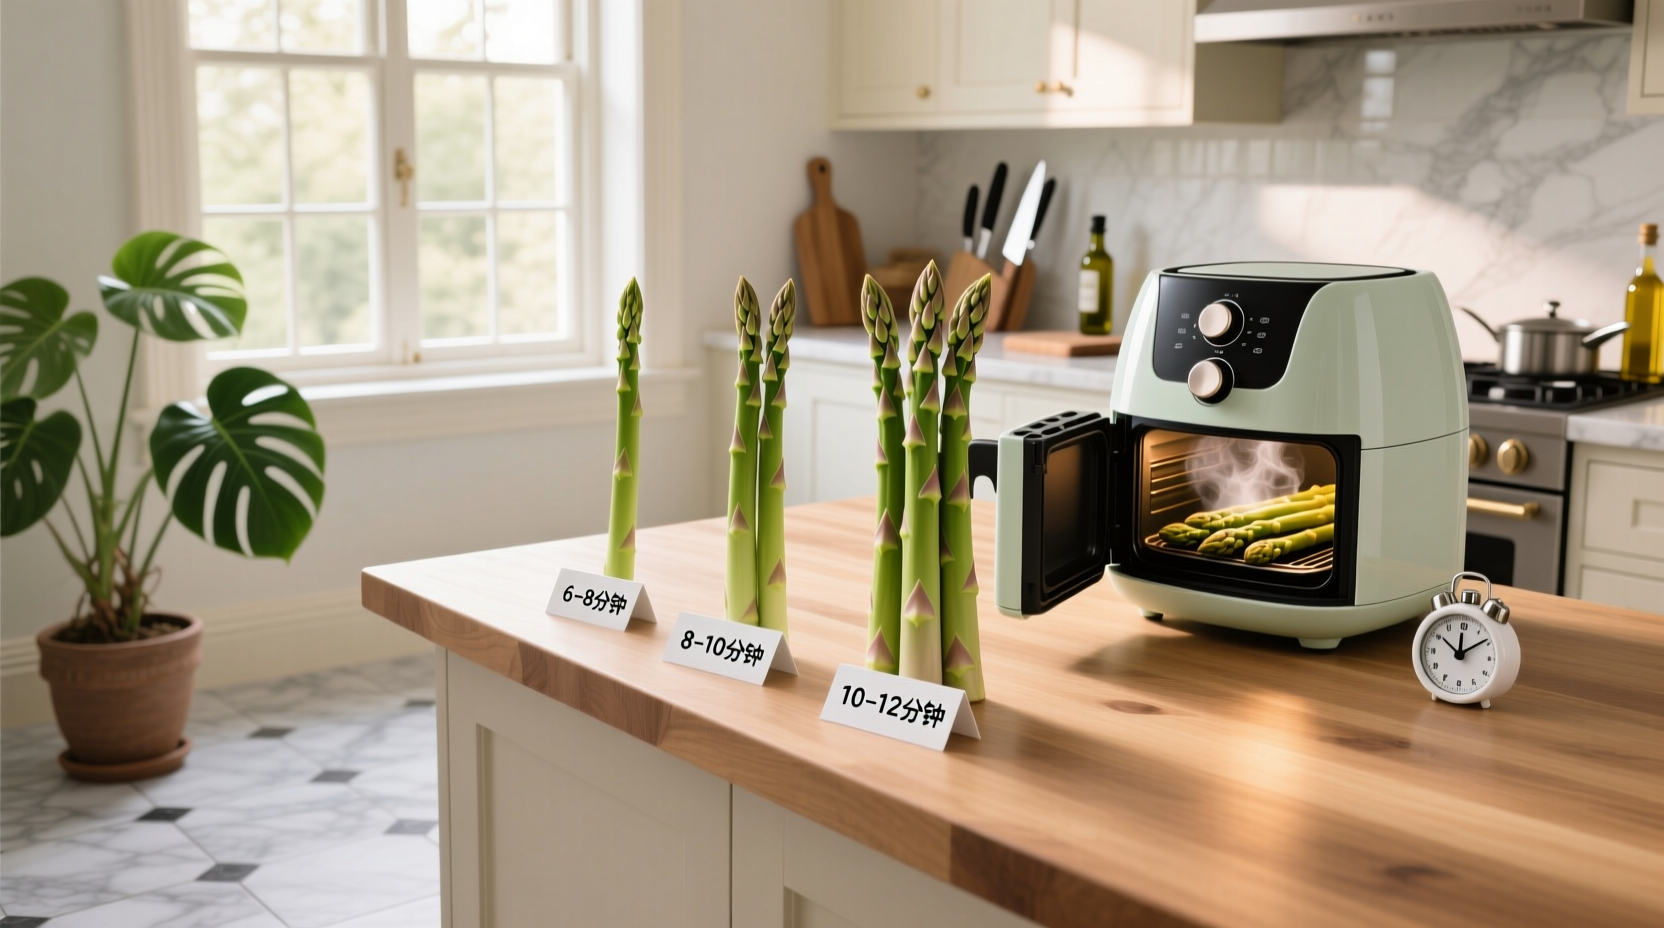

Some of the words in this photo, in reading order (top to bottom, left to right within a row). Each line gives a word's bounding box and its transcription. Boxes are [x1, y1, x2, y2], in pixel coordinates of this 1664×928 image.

[562, 585, 628, 616] 6-8分钟
[680, 630, 765, 668] 8-10分钟
[842, 685, 946, 729] 10-12分钟
